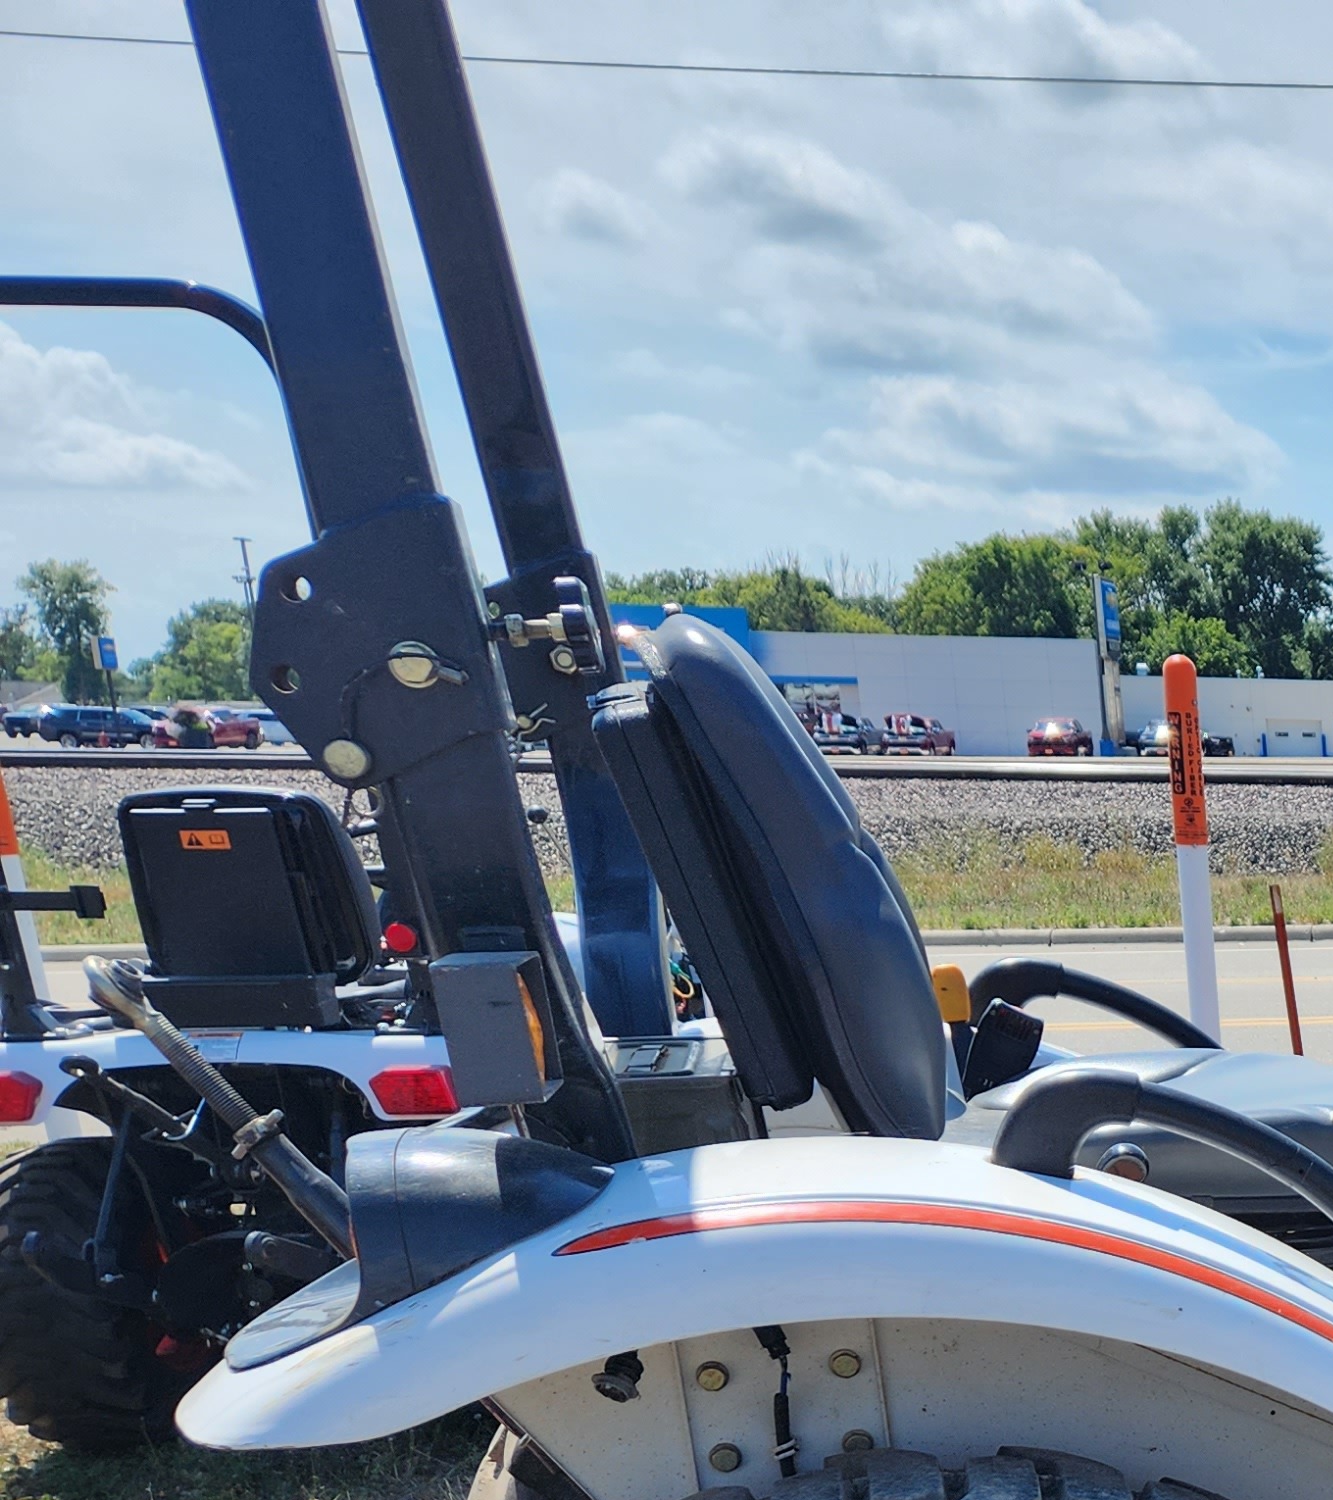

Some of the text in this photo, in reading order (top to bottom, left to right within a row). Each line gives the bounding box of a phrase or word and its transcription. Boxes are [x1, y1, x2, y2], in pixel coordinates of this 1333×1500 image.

[1168, 713, 1183, 793] WARNING
[1185, 712, 1197, 797] BURIED FIBER
